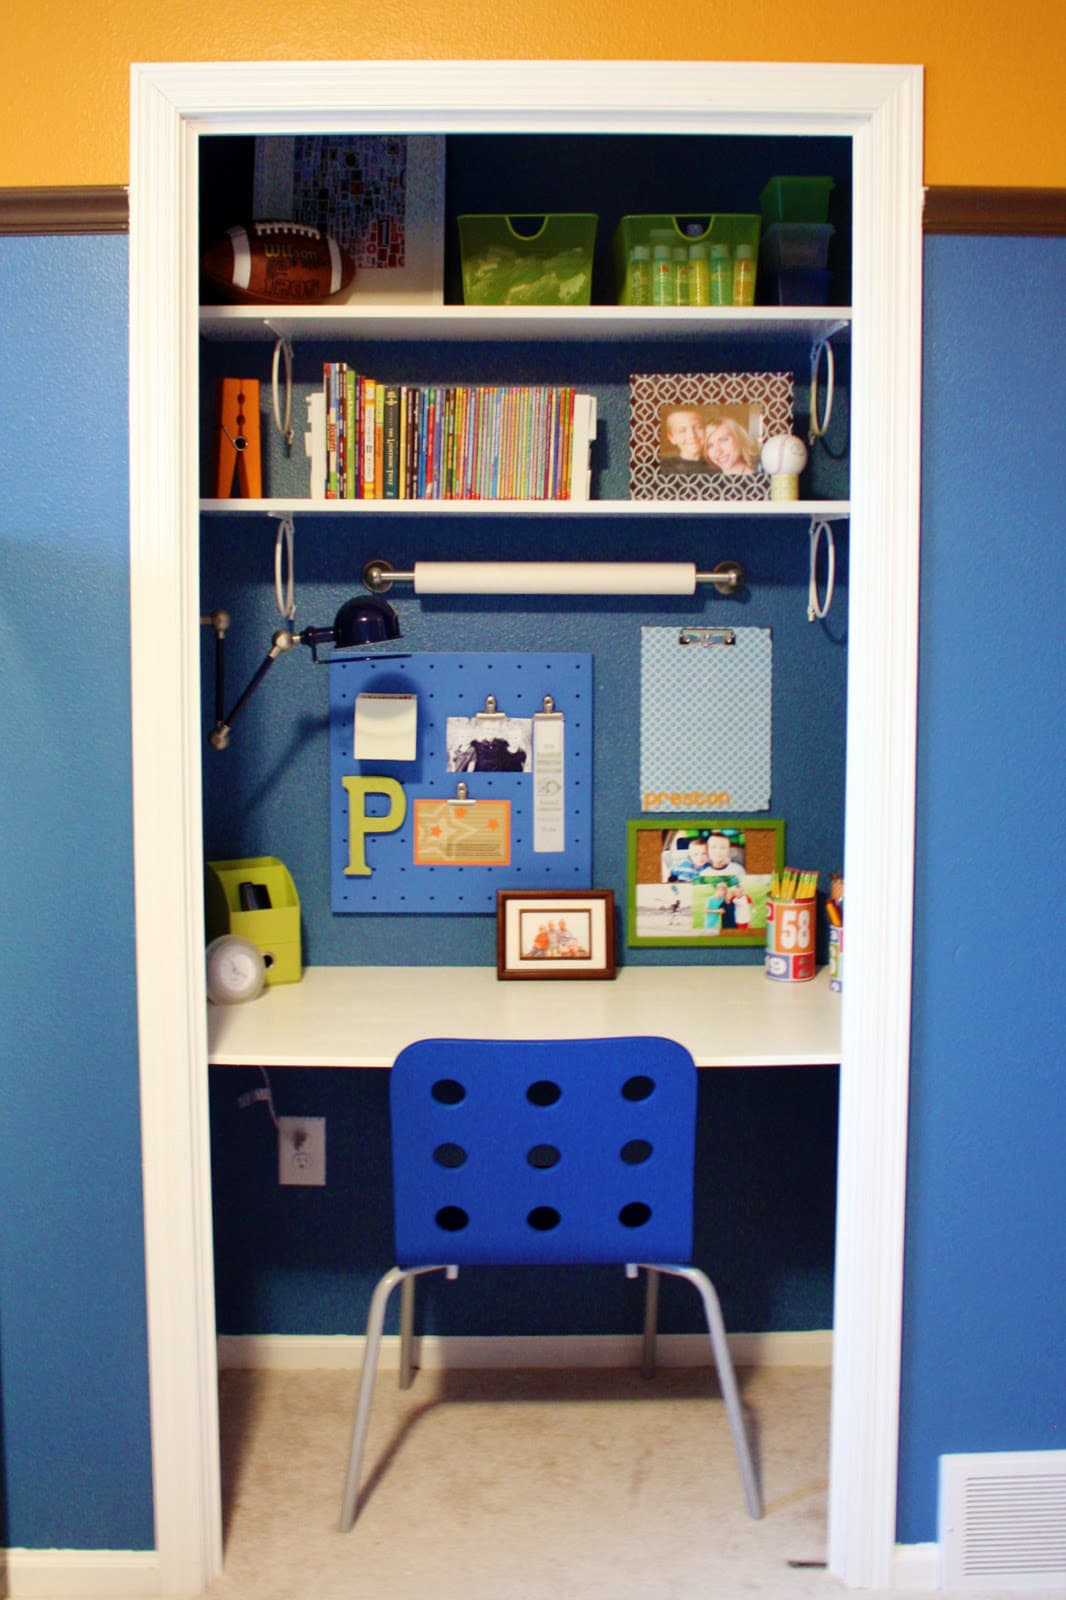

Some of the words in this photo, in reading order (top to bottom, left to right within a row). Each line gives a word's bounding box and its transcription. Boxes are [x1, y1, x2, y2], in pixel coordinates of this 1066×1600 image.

[264, 242, 318, 259] Wilson
[643, 790, 731, 812] preston
[342, 776, 406, 875] P
[780, 909, 810, 949] 58
